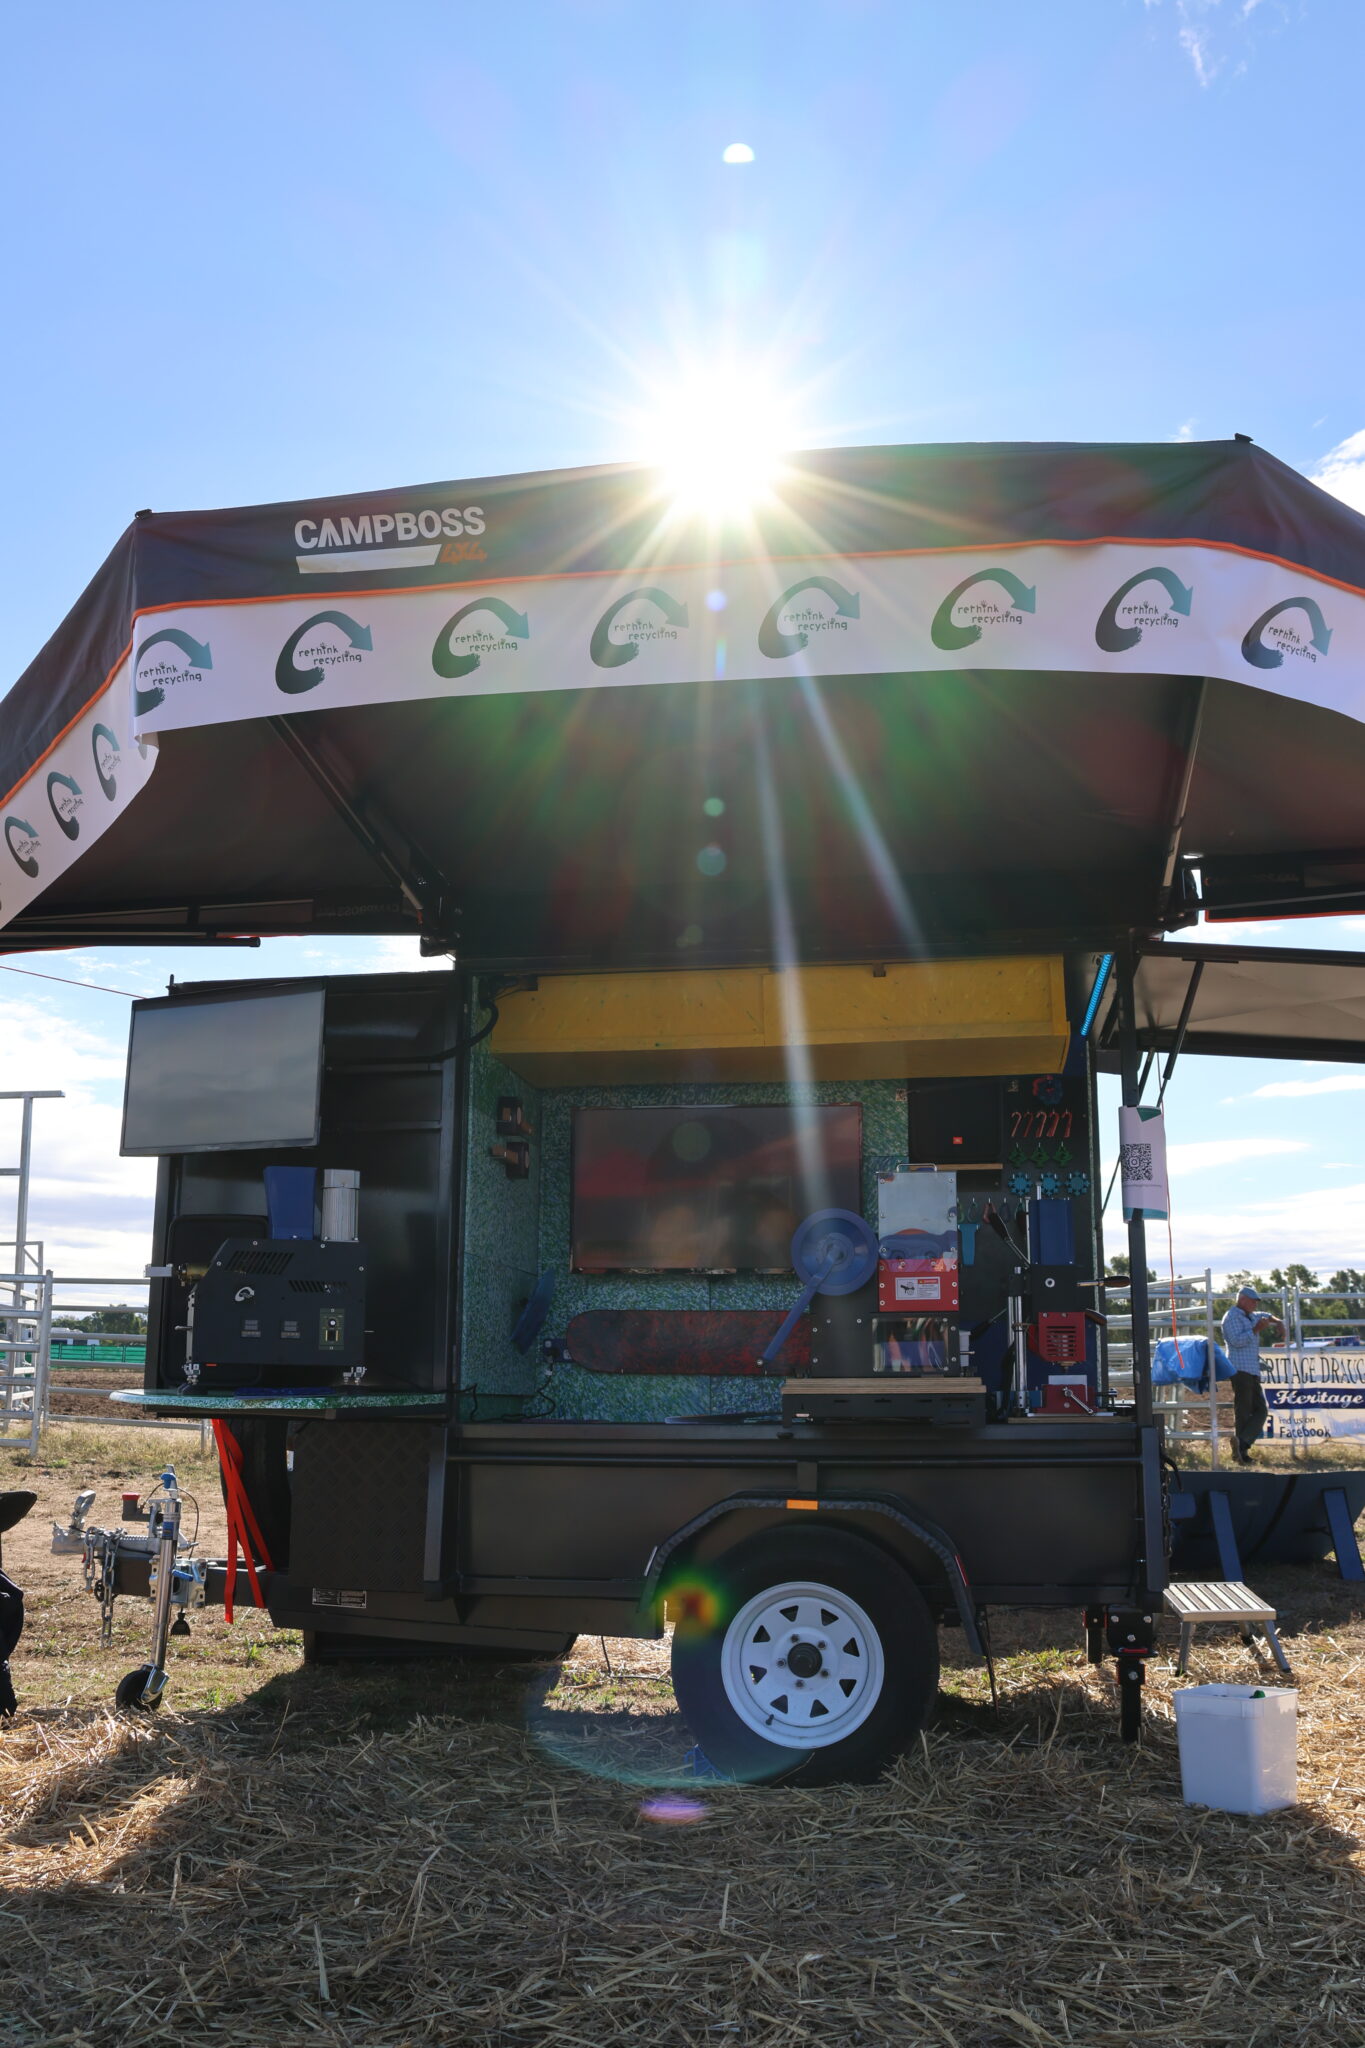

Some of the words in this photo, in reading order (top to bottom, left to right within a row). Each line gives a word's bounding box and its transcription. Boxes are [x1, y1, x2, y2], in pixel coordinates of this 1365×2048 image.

[294, 506, 486, 549] CAMPBOSS
[957, 600, 999, 614] rethink
[1122, 601, 1159, 616] rethink
[783, 608, 824, 623] rethink
[971, 611, 1023, 625] recycling
[1134, 613, 1179, 627] recycling
[614, 618, 654, 633] rethink
[798, 617, 848, 632] recycling
[454, 629, 494, 645] rethink
[628, 627, 677, 641] recycling
[1268, 624, 1301, 645] rethink
[299, 642, 339, 658] rethink
[469, 638, 518, 653] recycling
[1276, 638, 1317, 662] recycling
[313, 650, 362, 667] recycling
[138, 661, 178, 679] rethink
[152, 669, 202, 688] recycling
[1273, 1390, 1364, 1408] Heritage
[1280, 1426, 1331, 1438] Facebook
